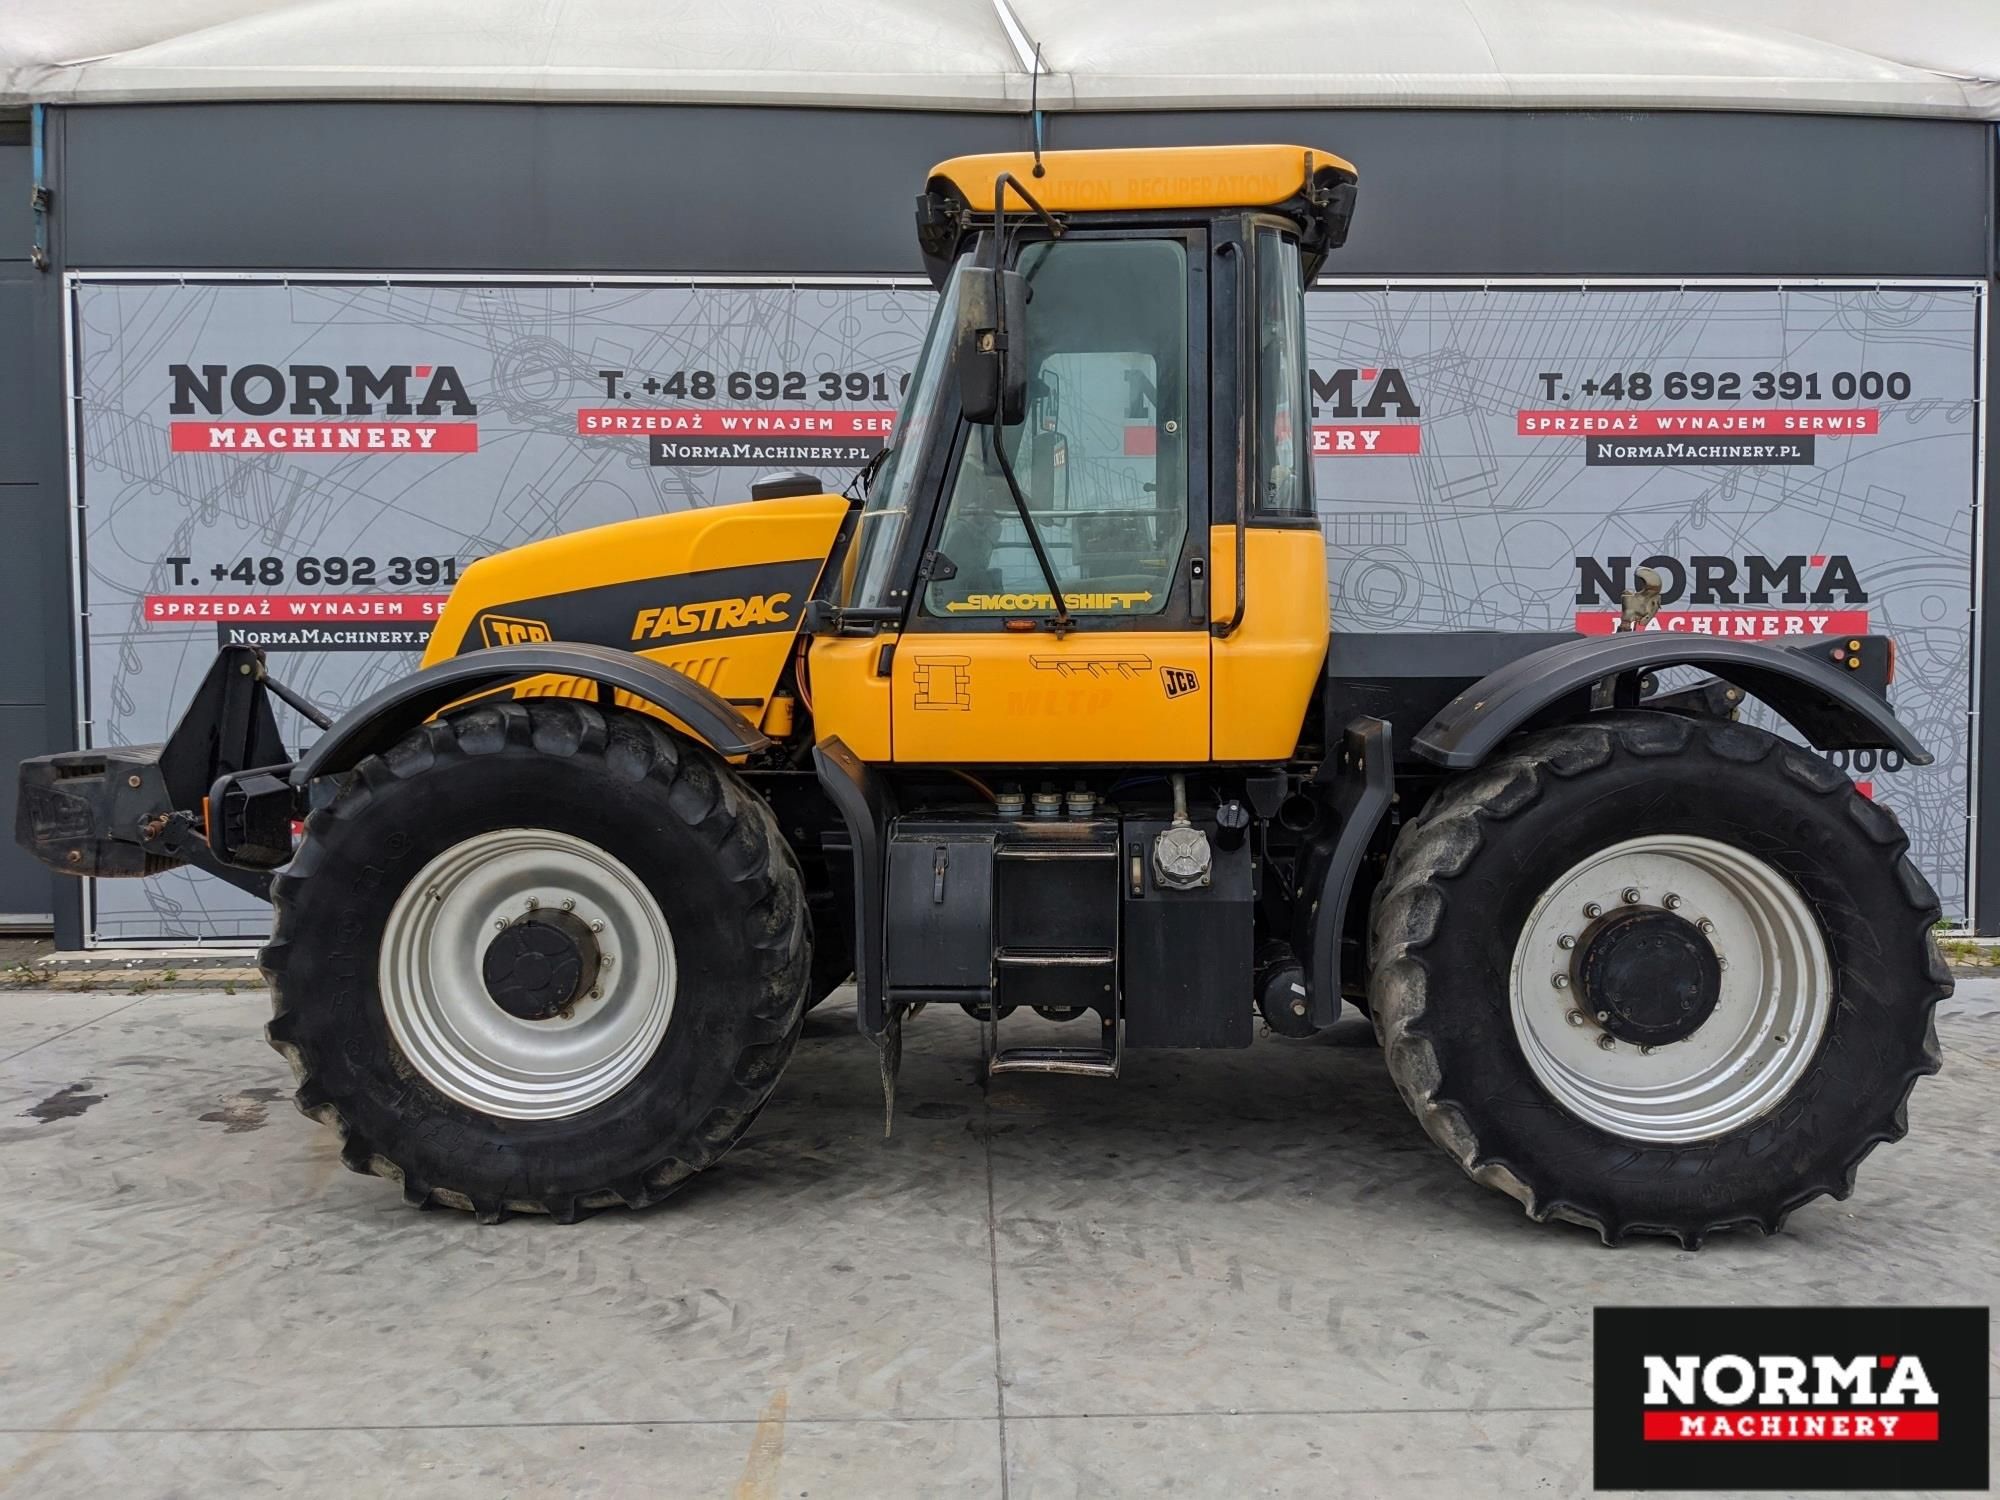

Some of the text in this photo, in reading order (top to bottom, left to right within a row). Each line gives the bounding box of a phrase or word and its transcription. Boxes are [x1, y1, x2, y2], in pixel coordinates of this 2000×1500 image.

[169, 364, 477, 416] NORMA
[598, 370, 631, 400] T.
[642, 370, 716, 400] +48
[728, 371, 807, 401] 692
[818, 371, 889, 401] 391
[1539, 371, 1911, 401] T. +48 692 391 000
[586, 413, 703, 430] SPRZEDAŻ
[721, 417, 833, 431] WYNAJEM
[852, 418, 893, 431] SER
[1526, 413, 1867, 430] SPRZEDAŻ WYNAJEM SERWIS
[209, 427, 437, 449] MACHINERY
[166, 557, 458, 586] T. +48 692 391
[1575, 555, 1869, 605] NORMA
[153, 599, 403, 616] SPRZEDAŻ WYNAJEM
[967, 593, 1132, 611] SMOOTSHIFT
[631, 592, 792, 641] FASTRAC
[1165, 669, 1197, 696] JCB
